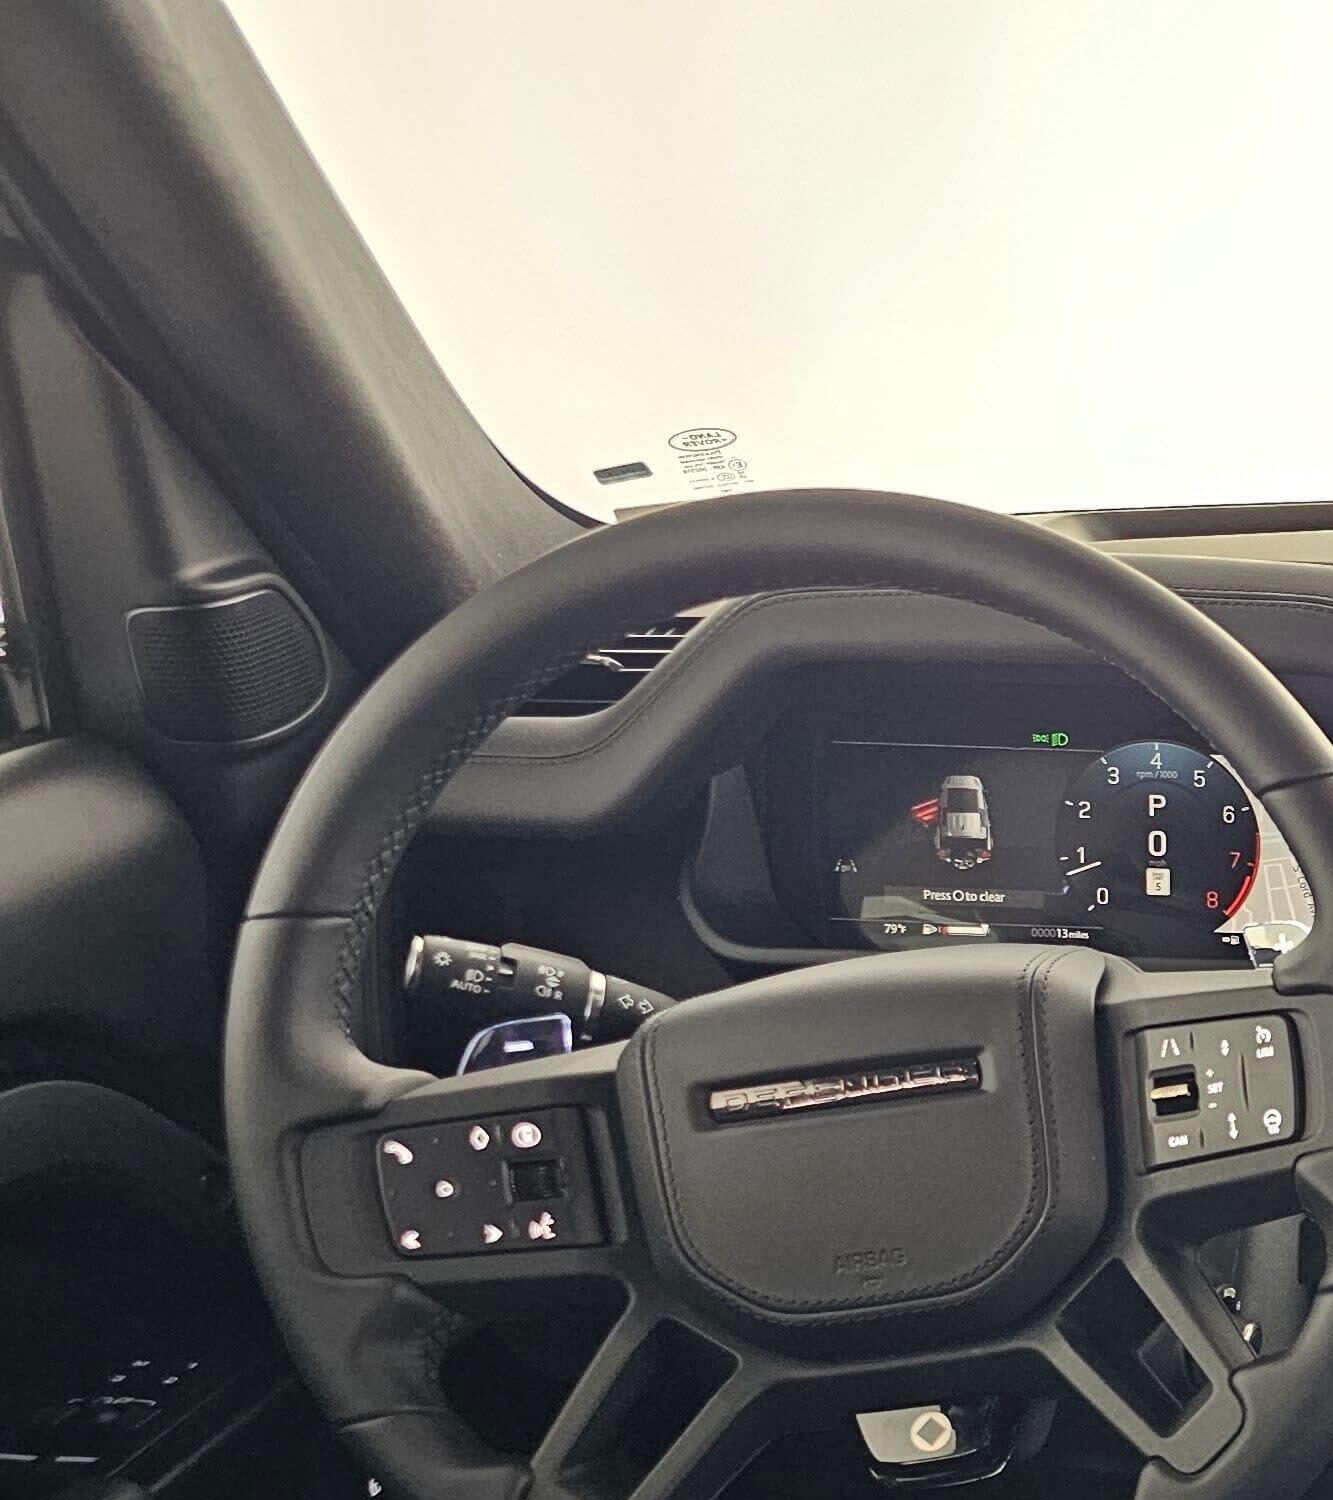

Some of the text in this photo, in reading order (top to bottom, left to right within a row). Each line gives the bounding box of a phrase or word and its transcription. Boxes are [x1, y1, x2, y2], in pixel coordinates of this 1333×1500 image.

[1150, 753, 1162, 769] 4
[1107, 767, 1120, 784] 3
[1193, 769, 1206, 788] 5
[1078, 801, 1091, 819] 2
[1149, 795, 1166, 816] P
[1223, 806, 1235, 824] 6
[1148, 830, 1167, 857] 0
[1076, 846, 1086, 863] 1
[1230, 852, 1241, 869] 7
[1156, 882, 1162, 891] 5
[923, 889, 1006, 903] Press to clear
[1097, 888, 1109, 905] 0
[1206, 891, 1218, 908] 8
[449, 979, 482, 994] AUTO
